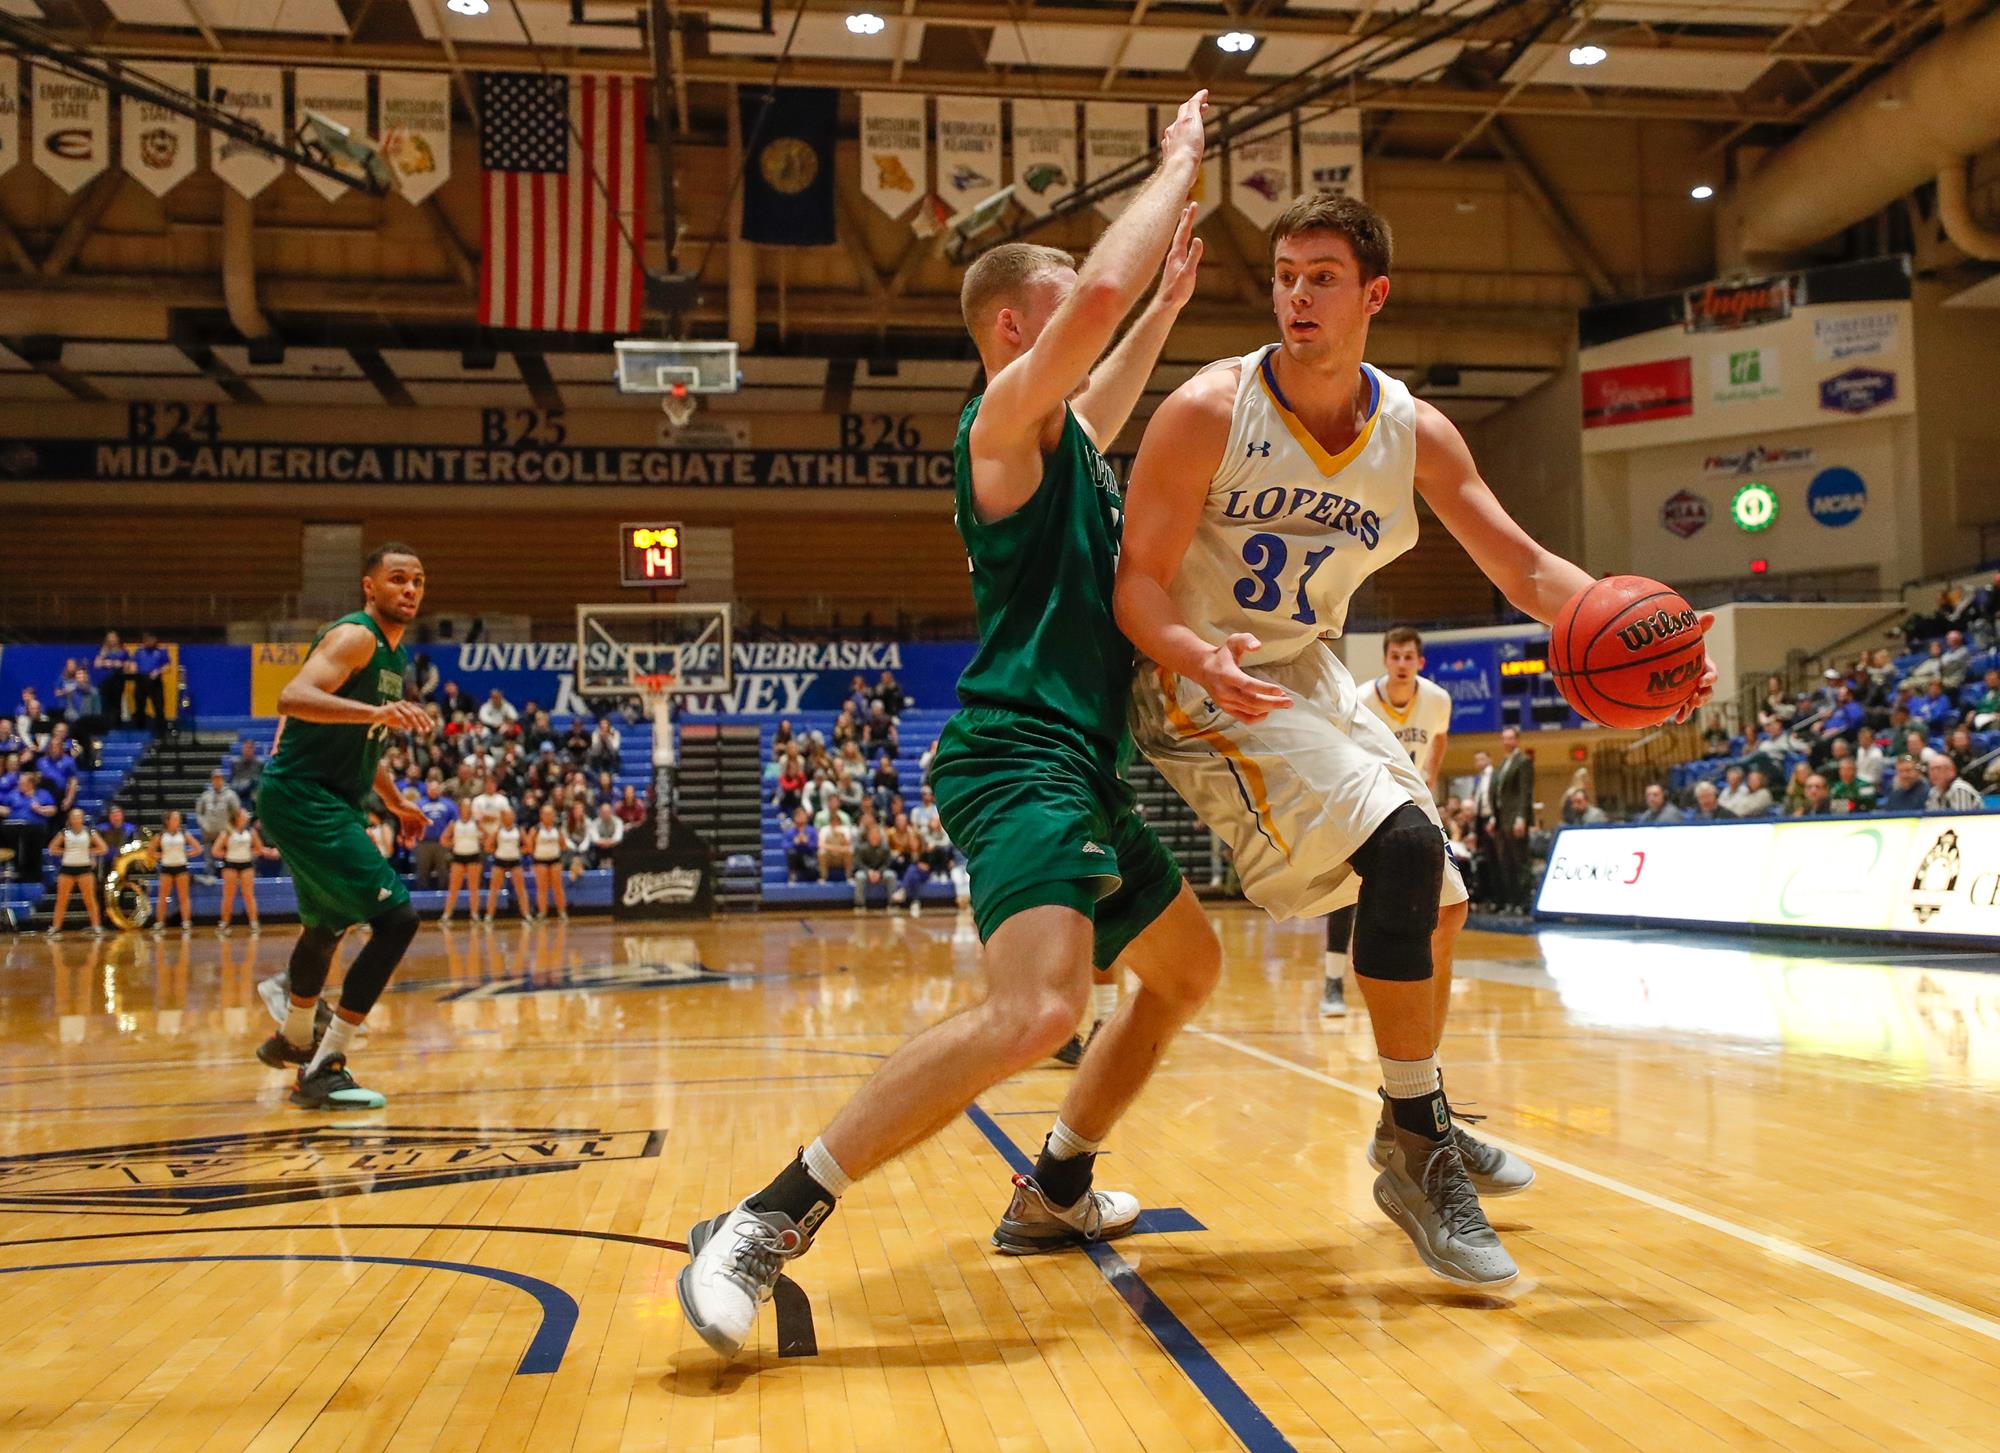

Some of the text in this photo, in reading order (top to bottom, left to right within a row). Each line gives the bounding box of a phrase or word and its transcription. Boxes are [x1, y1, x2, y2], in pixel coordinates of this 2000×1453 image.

[40, 84, 100, 101] EMPORIA
[51, 102, 88, 118] STATE
[128, 401, 221, 442] B24
[481, 409, 567, 447] B25
[840, 414, 922, 450] B26
[96, 446, 953, 485] MID-AMERICA INTERCOLLEGIATE ATHLETIC
[1222, 486, 1381, 550] LOPERS
[646, 548, 673, 577] 14
[1233, 533, 1335, 625] 31
[1616, 609, 1699, 652] Wilson
[731, 642, 902, 671] NEBRASKA
